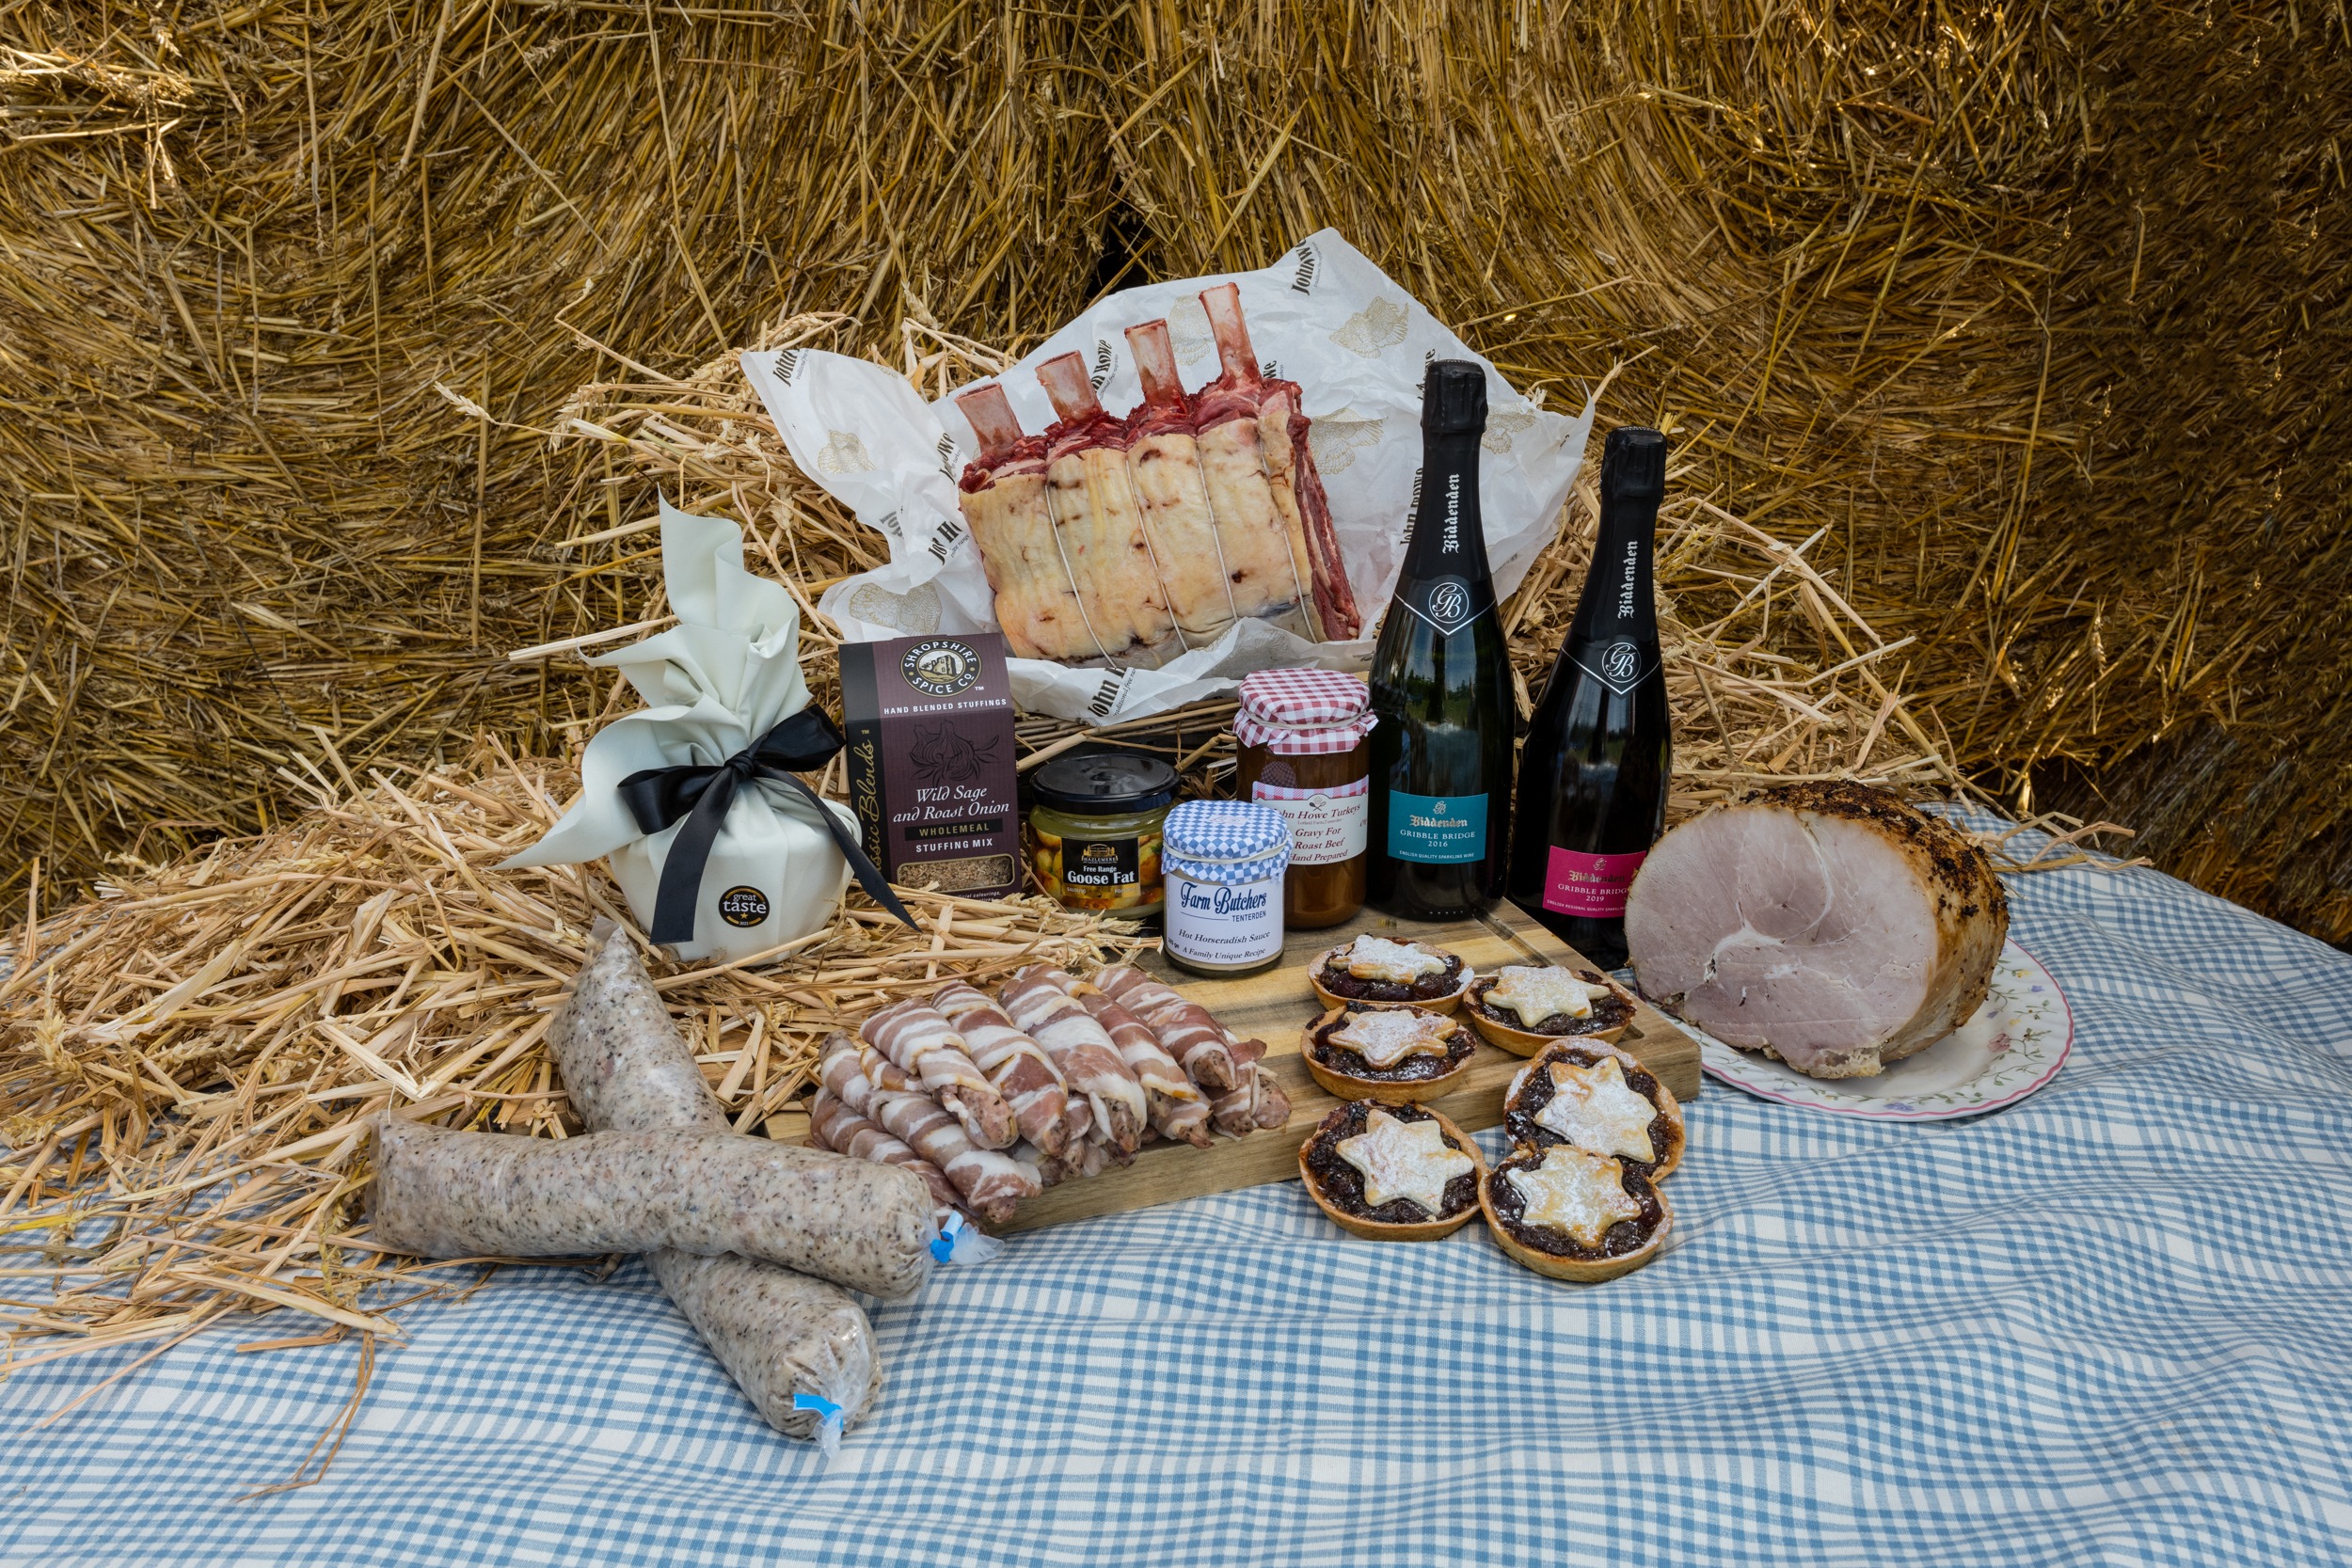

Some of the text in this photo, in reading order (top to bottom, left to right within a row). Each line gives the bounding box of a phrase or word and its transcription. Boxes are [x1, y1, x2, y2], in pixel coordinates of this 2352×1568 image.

[772, 350, 798, 388] John
[1442, 473, 1459, 554] Biddenden
[1617, 540, 1638, 619] Biddenden
[904, 641, 977, 668] SHROPSHIRE
[913, 677, 953, 694] SPICE
[1088, 679, 1120, 717] John
[883, 698, 1007, 715] HAND BLENDED STUFFINGS
[853, 738, 880, 823] Blends
[916, 785, 988, 802] Wild Sage
[893, 800, 1009, 823] and Roast Onion
[1297, 811, 1327, 819] Howe
[1330, 803, 1361, 818] Turkeys
[1409, 815, 1469, 828] Biddenden
[919, 823, 990, 836] WHOLEMEAL
[1295, 827, 1343, 839] Gravy For
[1399, 829, 1476, 840] GRIBBLE BRIDGE
[915, 838, 993, 852] STUFFING MIX
[1294, 836, 1346, 850] Roast Beef
[1313, 848, 1348, 863] Prepared
[1067, 870, 1135, 885] Goose Fat
[1557, 883, 1629, 895] GRIBBLE BRIDG
[733, 894, 756, 902] great
[1181, 881, 1211, 910] Farm
[1214, 886, 1267, 915] Butchers
[1547, 898, 1565, 907] ENGLISH
[723, 900, 767, 914] taste
[1232, 910, 1266, 923] TENTERDEN
[1178, 928, 1271, 944] Hot Horseradish Sauce
[1188, 948, 1214, 959] Family
[1215, 952, 1243, 960] Unique
[1244, 948, 1266, 958] Recipe
